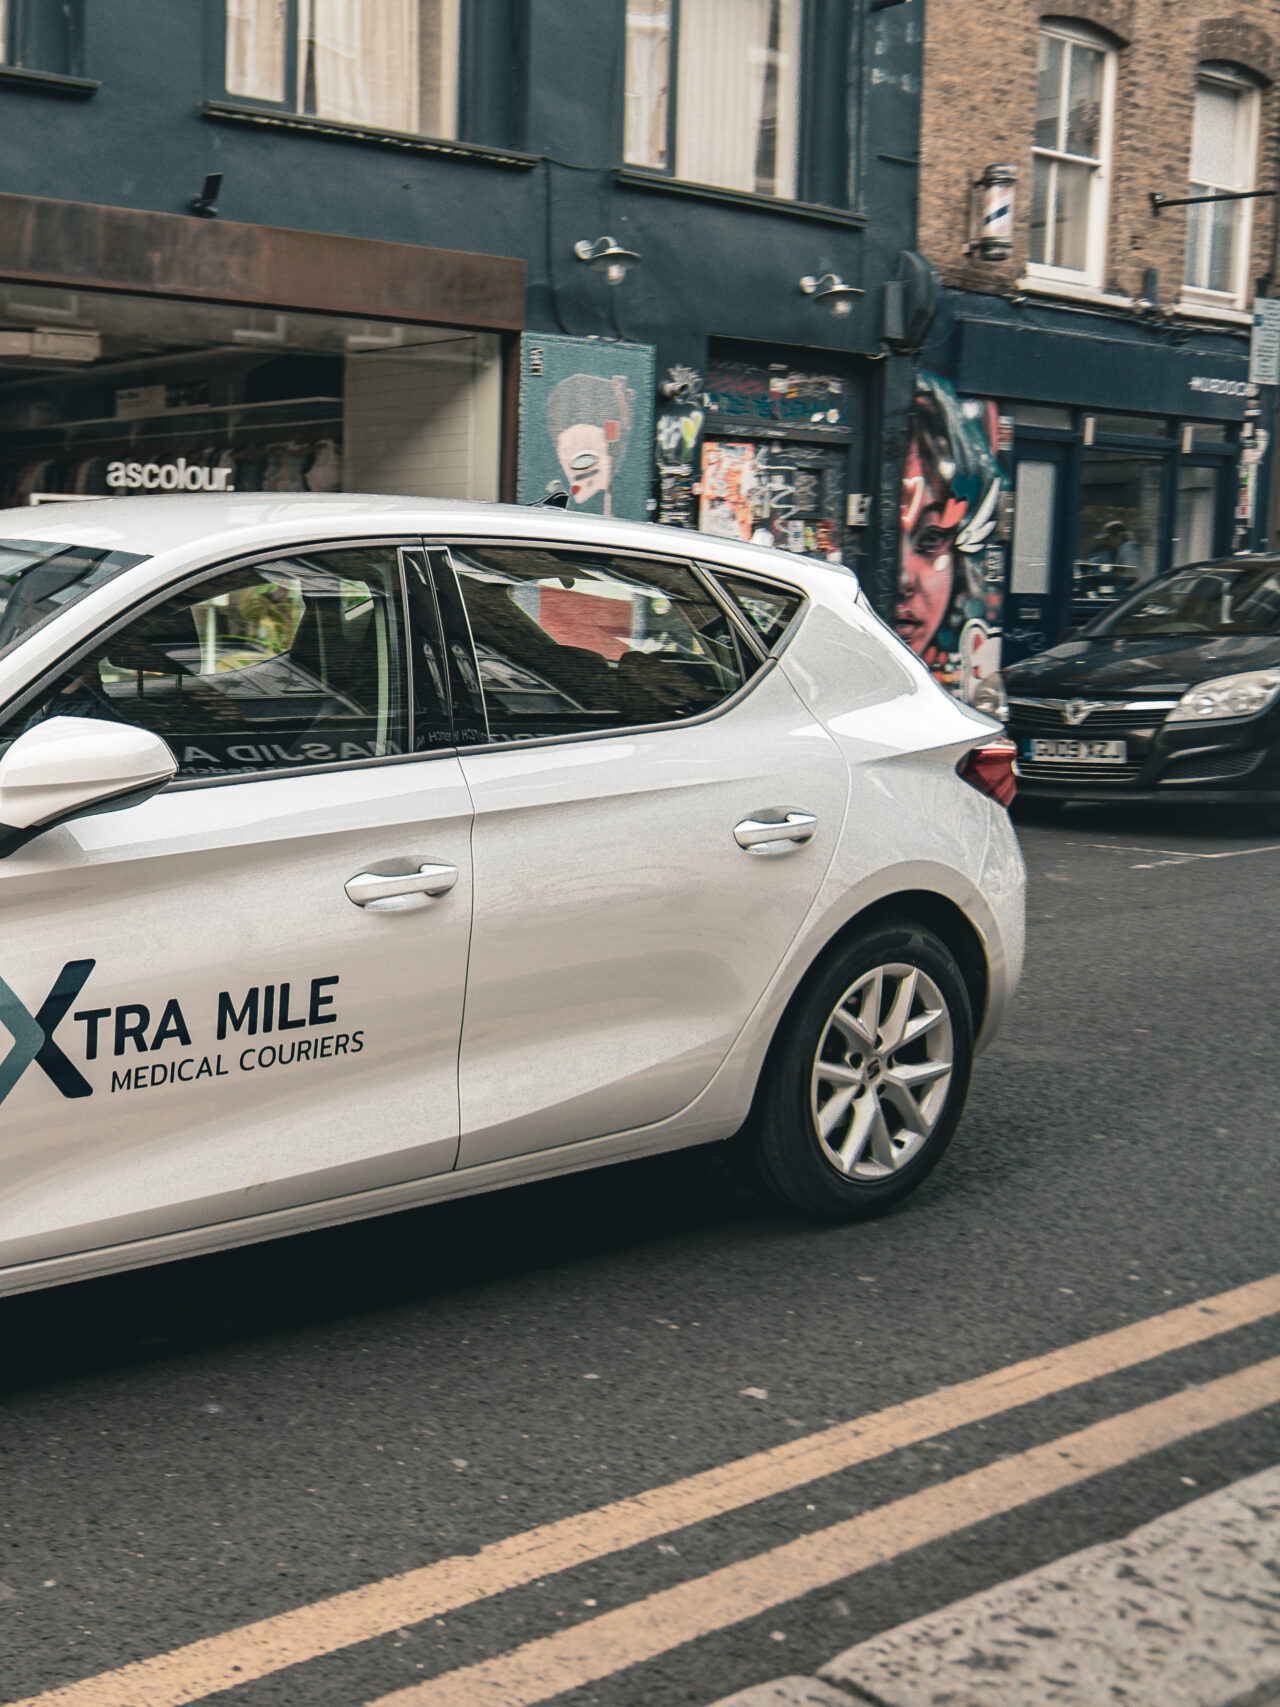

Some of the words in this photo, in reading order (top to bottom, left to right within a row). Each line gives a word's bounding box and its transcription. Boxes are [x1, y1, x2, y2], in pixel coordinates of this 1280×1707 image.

[106, 457, 235, 491] ascolour.
[216, 975, 340, 1041] MILE
[111, 1054, 229, 1093] MEDICAL
[239, 1030, 365, 1072] COURIERS
